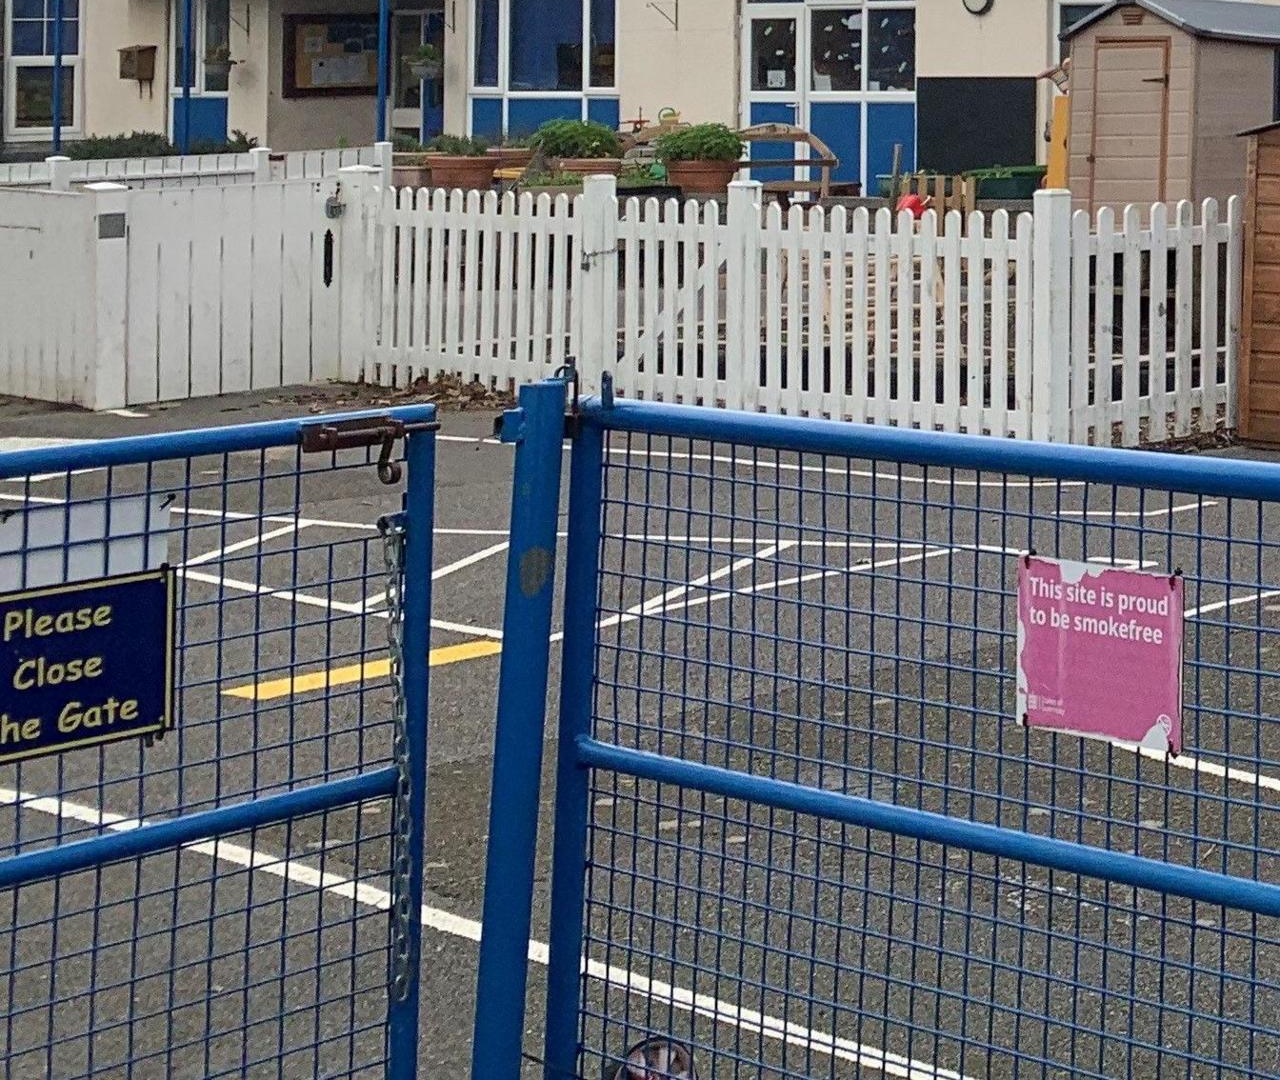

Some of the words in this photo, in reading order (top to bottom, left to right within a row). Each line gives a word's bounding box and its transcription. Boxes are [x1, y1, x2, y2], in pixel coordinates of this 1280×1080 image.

[1030, 576, 1062, 601] This
[1066, 584, 1096, 606] site
[1101, 587, 1114, 609] is
[1118, 593, 1169, 618] proud
[4, 604, 113, 642] Please
[1029, 605, 1047, 624] to
[1051, 607, 1070, 629] be
[1074, 614, 1164, 645] smokefree
[13, 656, 104, 691] Close
[0, 713, 41, 745] he
[57, 696, 139, 734] Gate
